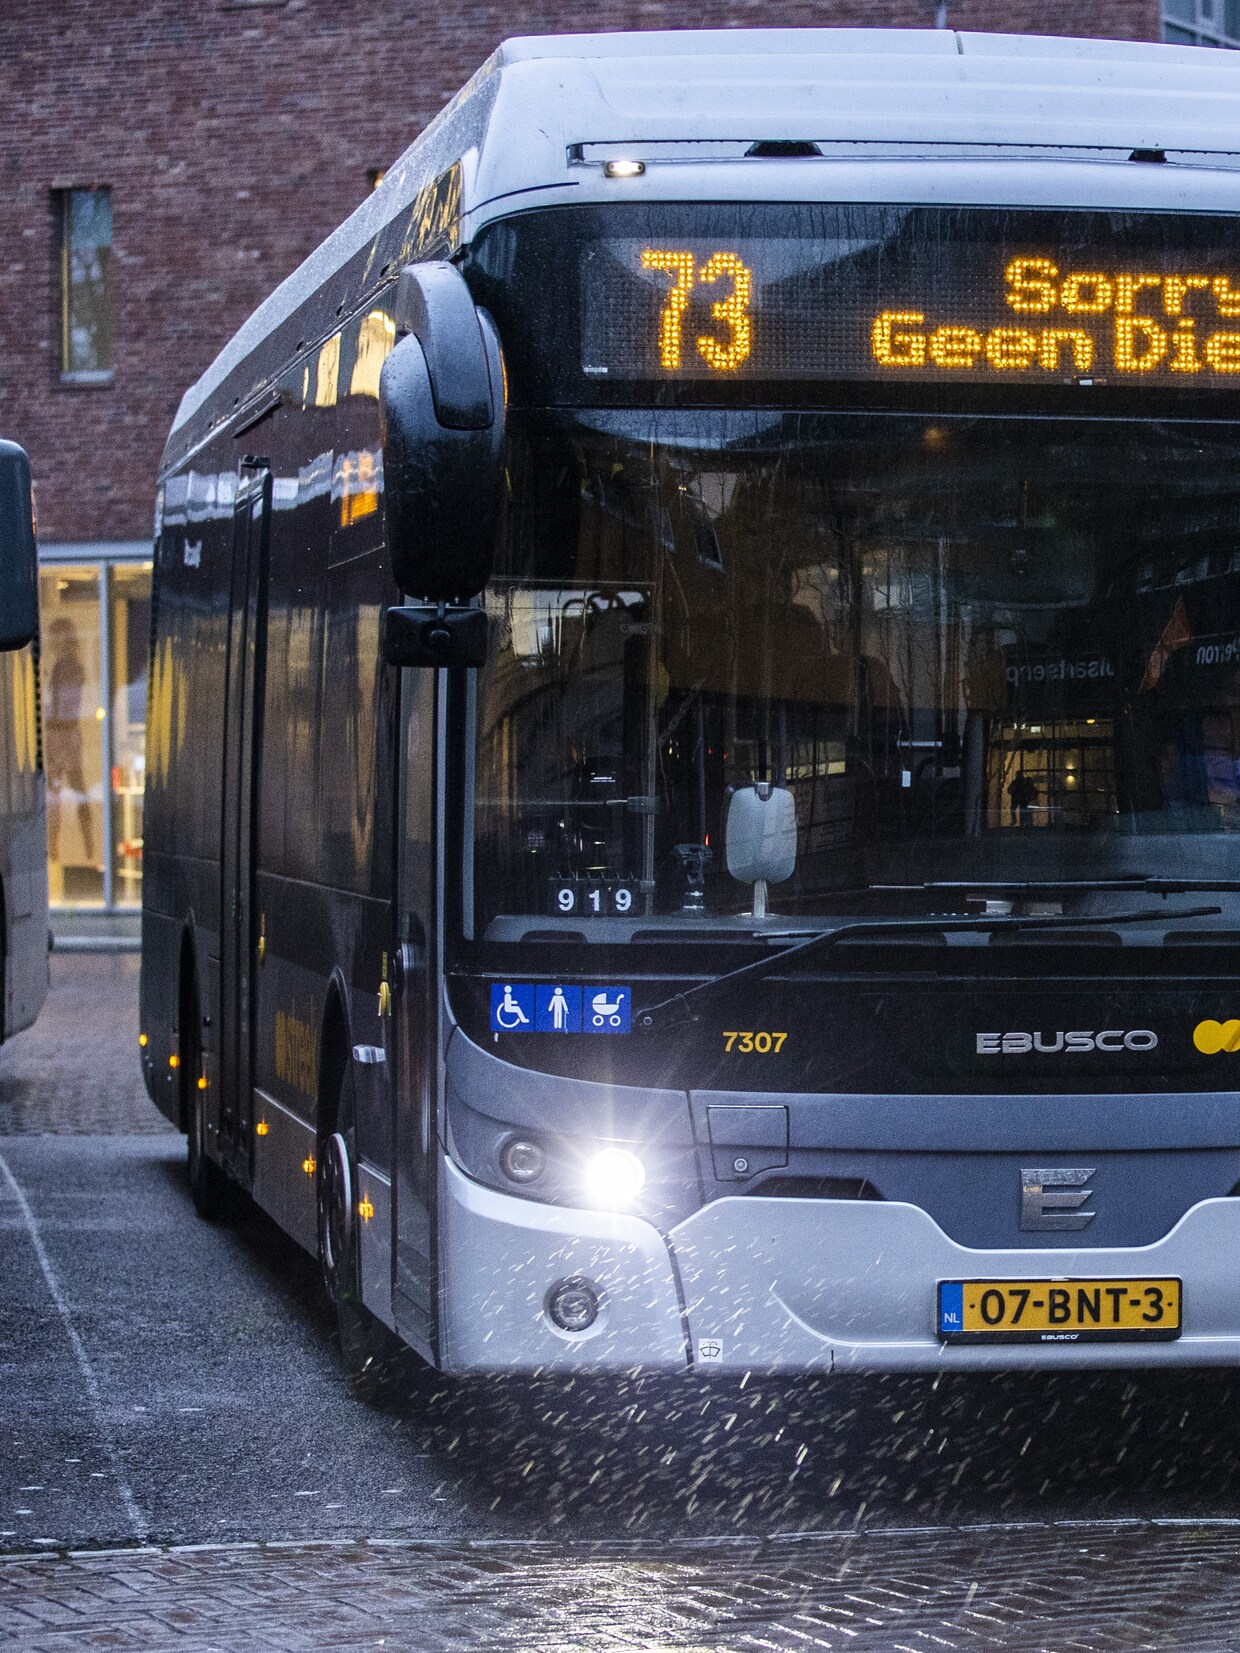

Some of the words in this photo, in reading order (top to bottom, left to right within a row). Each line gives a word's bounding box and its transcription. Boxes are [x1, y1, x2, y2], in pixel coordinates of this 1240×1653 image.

[640, 249, 751, 369] 73
[871, 308, 1097, 371] Geen
[722, 1031, 788, 1053] 7307
[976, 1030, 1158, 1054] EBUSCO
[944, 1312, 960, 1324] NL
[980, 1286, 1164, 1325] 07-BNT-3
